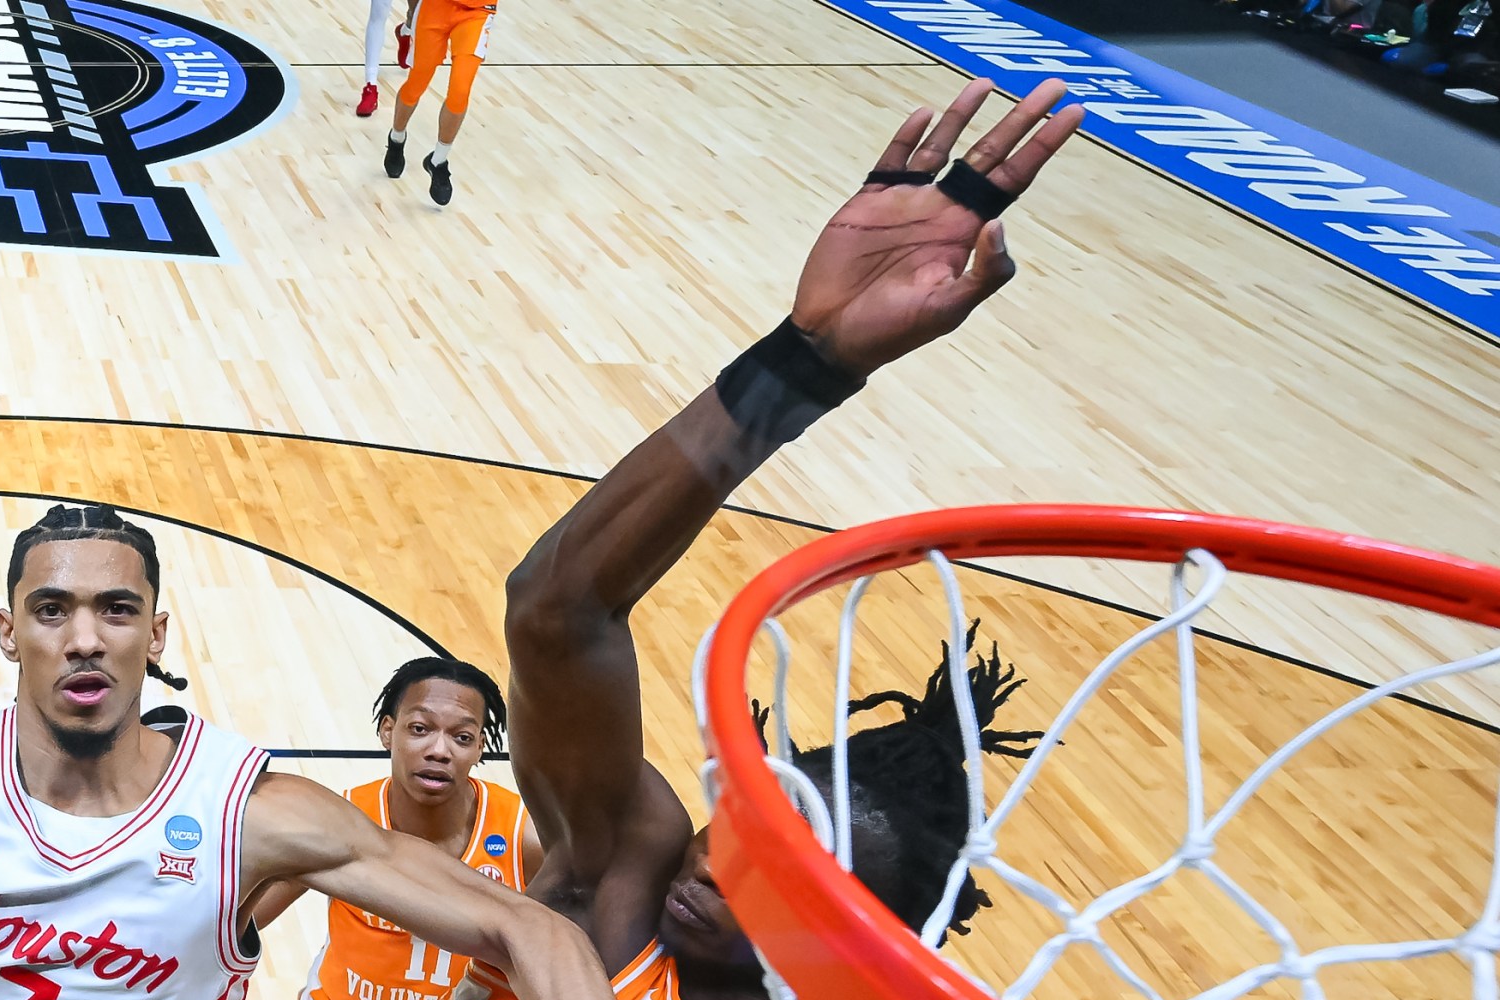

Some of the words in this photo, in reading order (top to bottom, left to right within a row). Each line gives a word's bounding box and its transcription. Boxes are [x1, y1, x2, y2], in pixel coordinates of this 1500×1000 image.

[147, 37, 197, 48] 8
[865, 0, 1132, 75] FINAL
[164, 51, 230, 98] ELITE
[1083, 101, 1452, 218] ROAD
[1323, 222, 1500, 296] THE
[169, 829, 200, 842] NCAA
[486, 843, 506, 852] NCAA
[404, 935, 452, 987] 11
